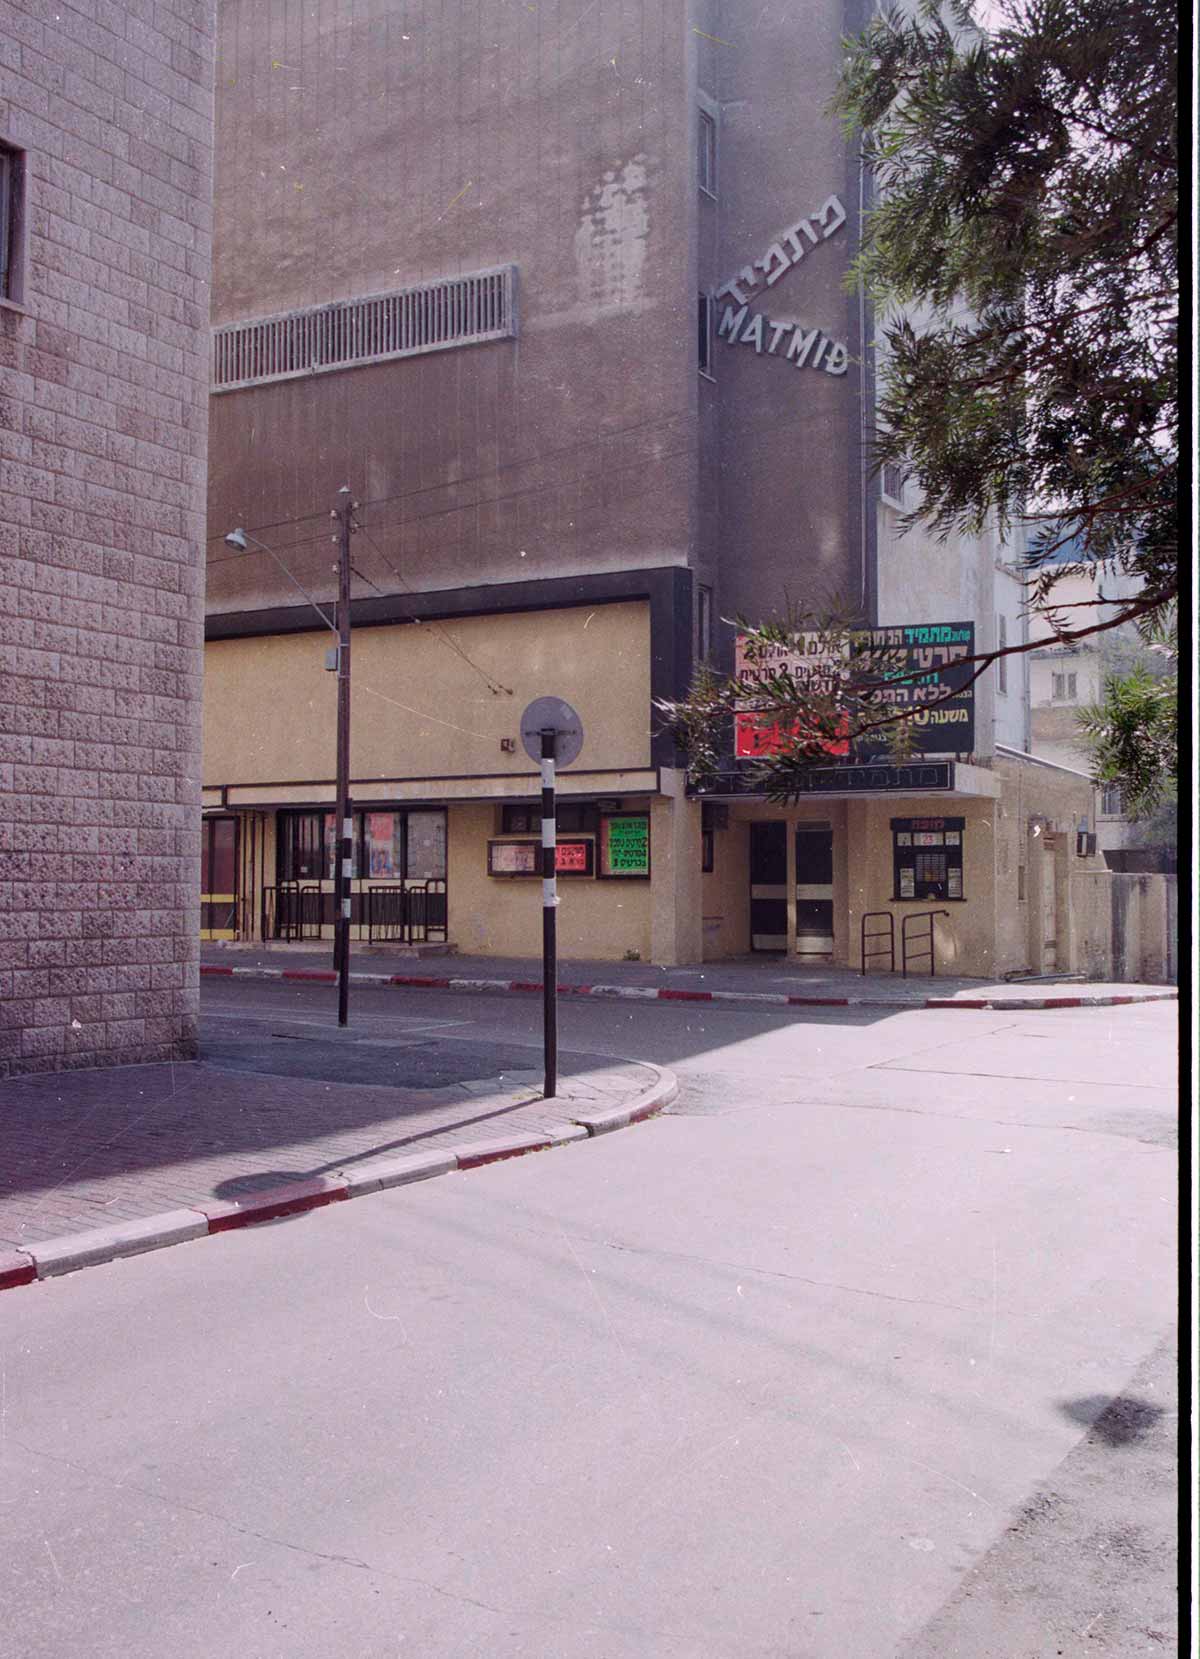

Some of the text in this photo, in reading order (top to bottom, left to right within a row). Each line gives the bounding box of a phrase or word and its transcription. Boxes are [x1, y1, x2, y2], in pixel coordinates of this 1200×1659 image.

[716, 194, 847, 305] מתמיד
[718, 305, 848, 375] MATMID
[904, 626, 952, 645] מתמיד
[913, 683, 952, 701] ללא
[930, 708, 969, 724] משעה
